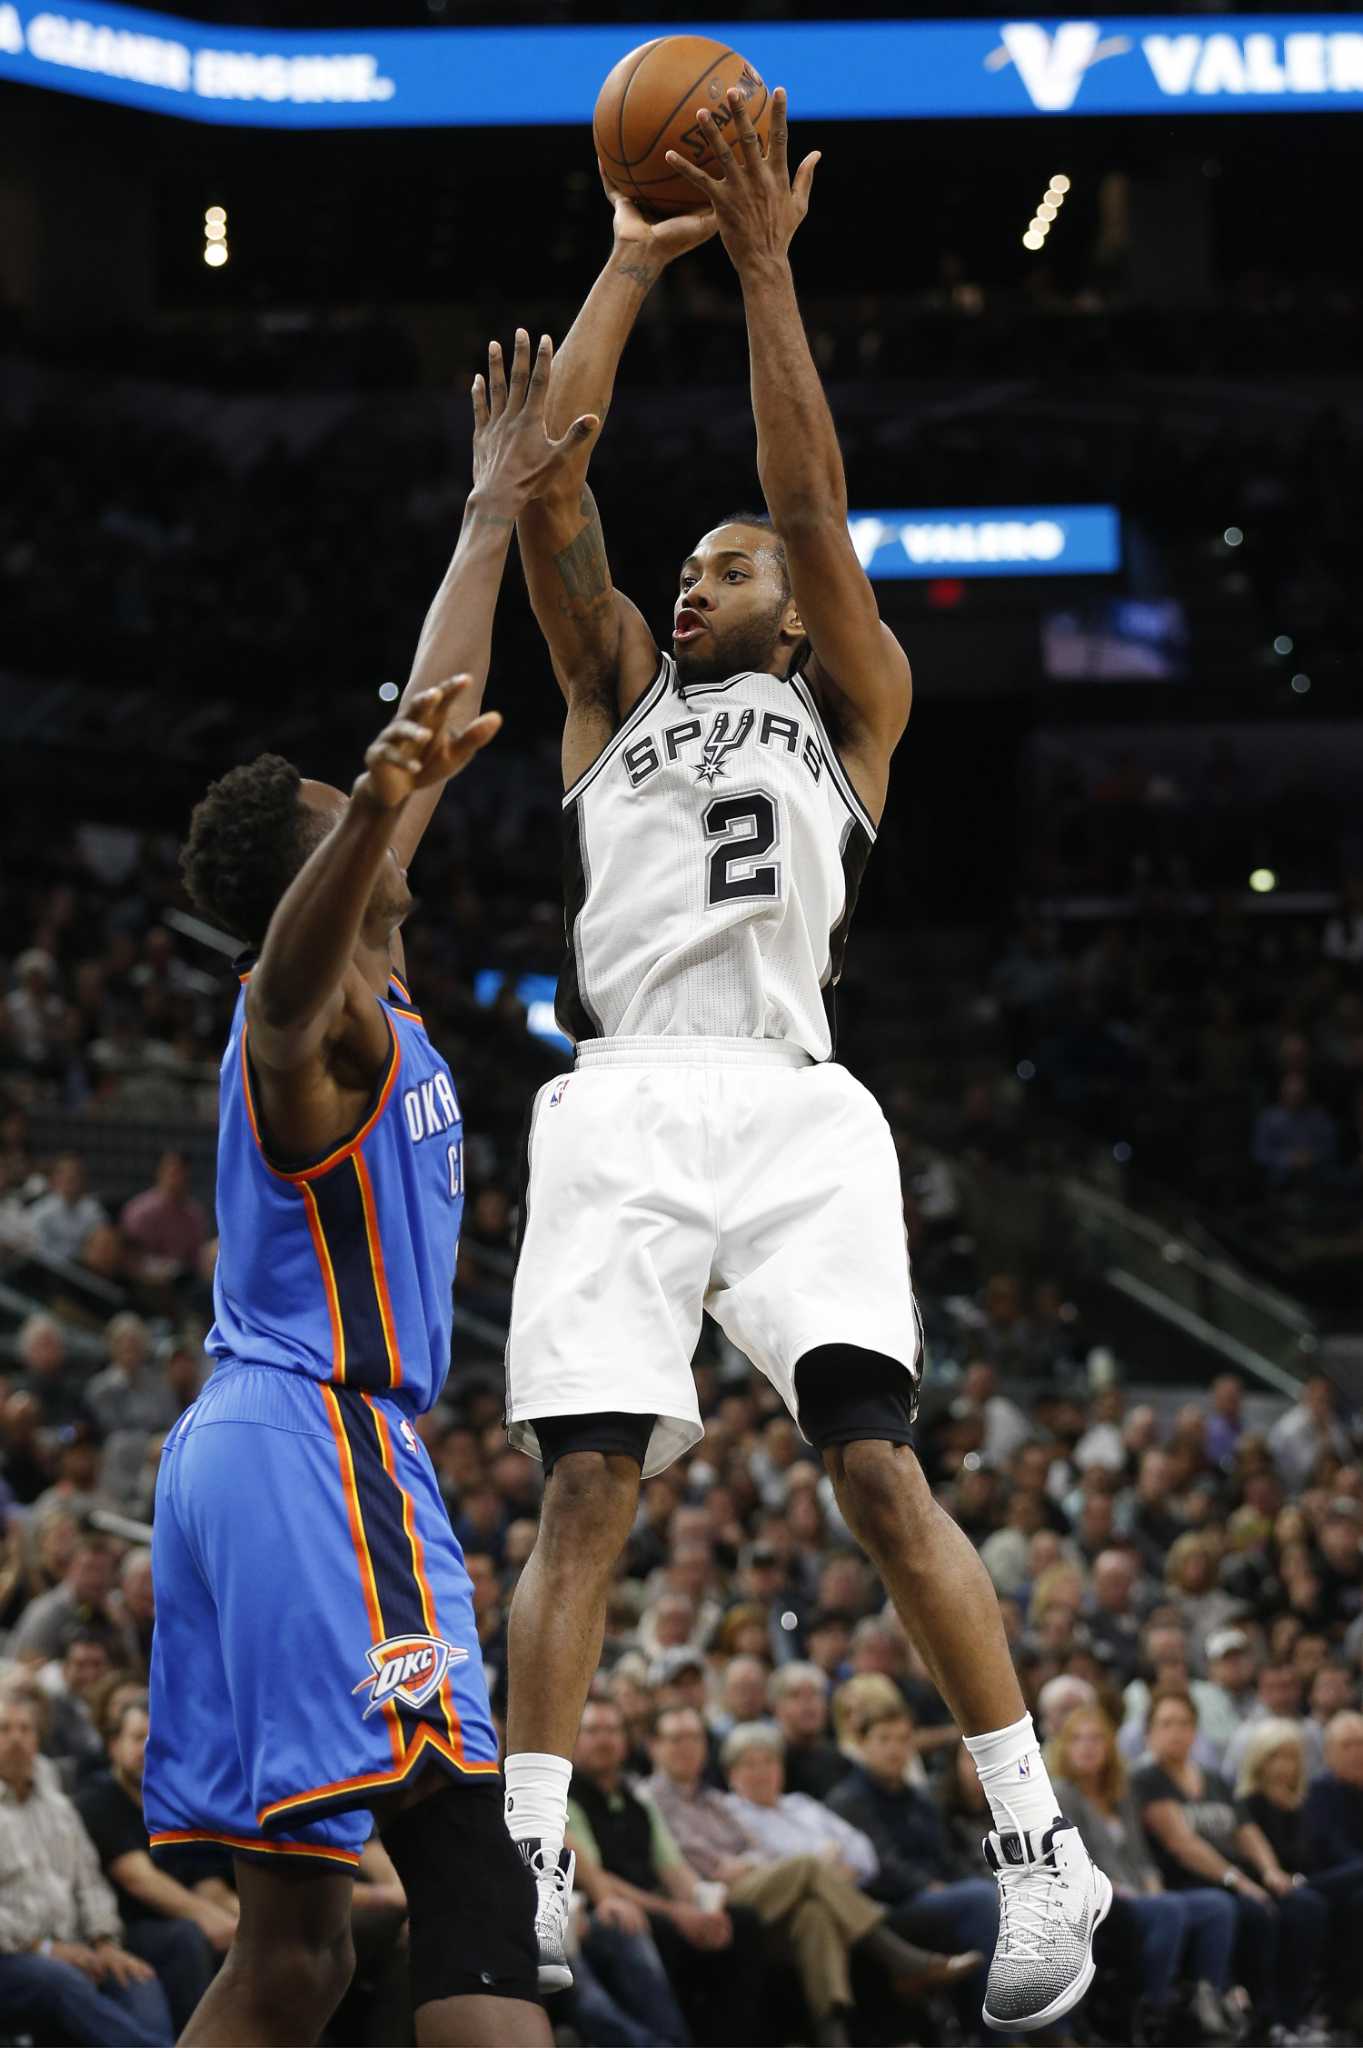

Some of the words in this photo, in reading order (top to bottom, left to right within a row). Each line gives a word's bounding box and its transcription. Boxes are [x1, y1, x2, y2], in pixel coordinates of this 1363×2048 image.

[622, 708, 822, 788] SPURS
[701, 788, 781, 912] 2
[374, 1647, 433, 1699] OKC
